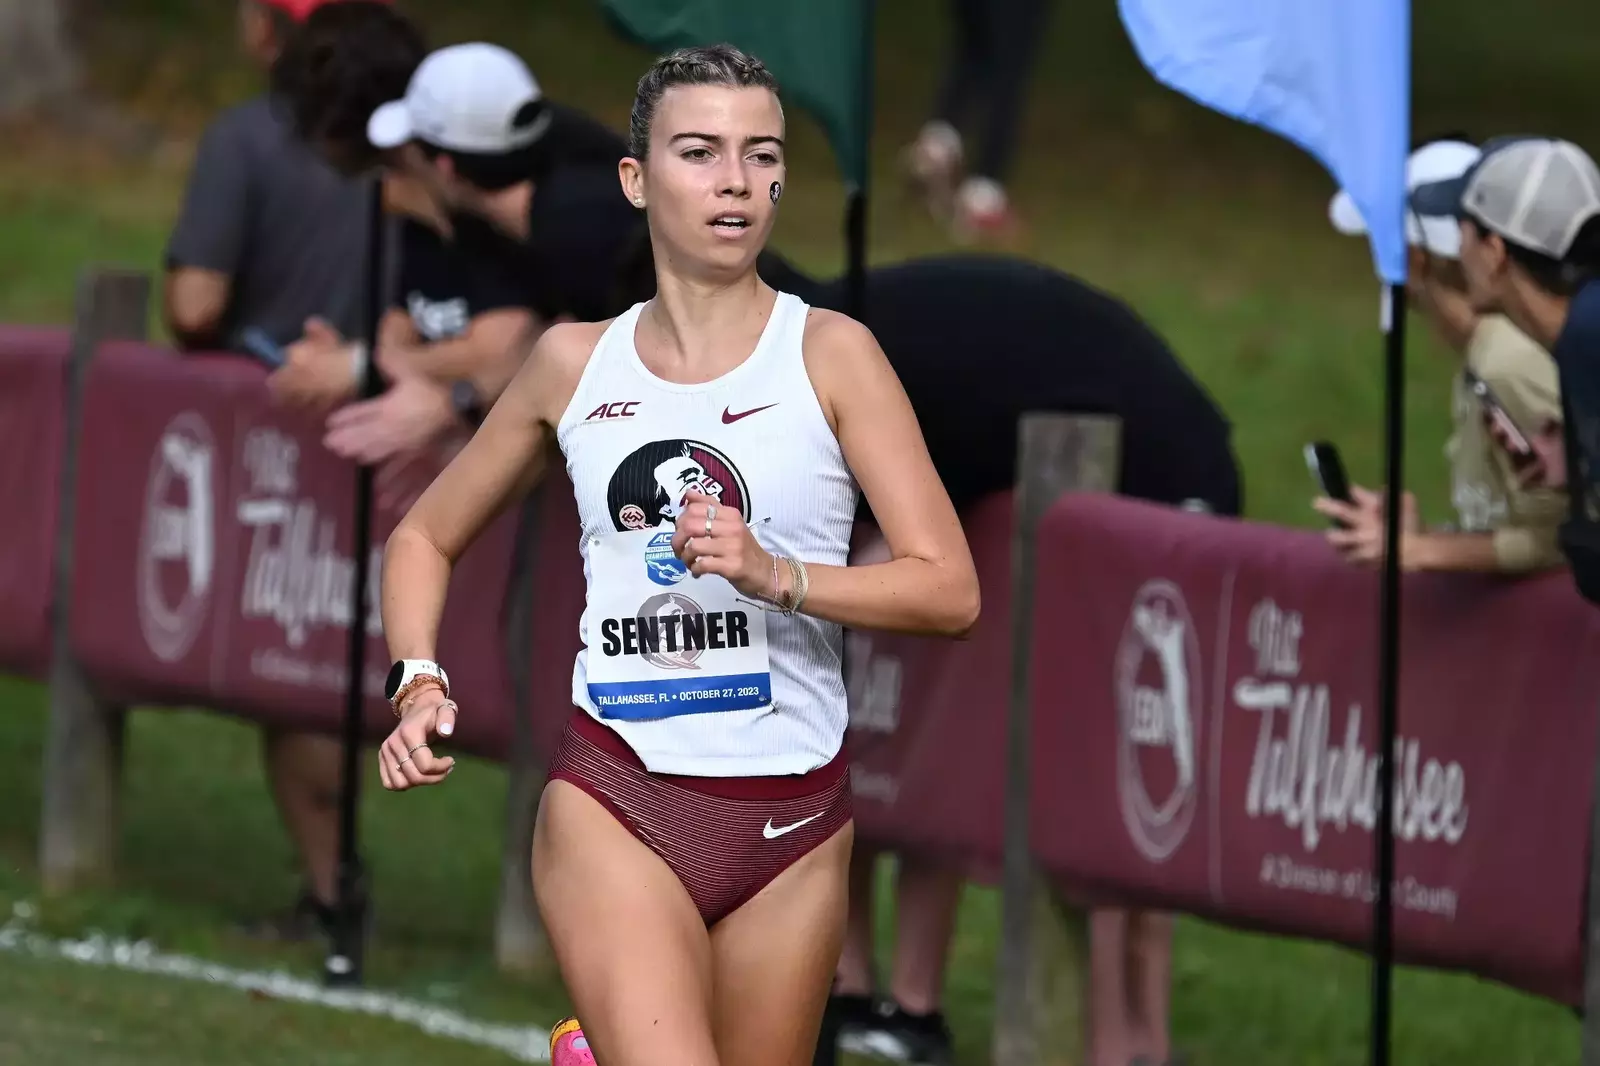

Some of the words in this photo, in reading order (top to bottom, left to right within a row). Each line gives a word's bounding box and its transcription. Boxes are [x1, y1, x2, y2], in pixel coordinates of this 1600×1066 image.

[585, 402, 642, 420] ACC
[653, 534, 674, 543] AC
[601, 610, 750, 657] SENTNER
[598, 693, 657, 706] TALLAHASSEE,
[659, 694, 670, 702] FL
[679, 690, 721, 701] OCTOBER
[722, 688, 736, 699] 27,
[737, 687, 760, 697] 2023
